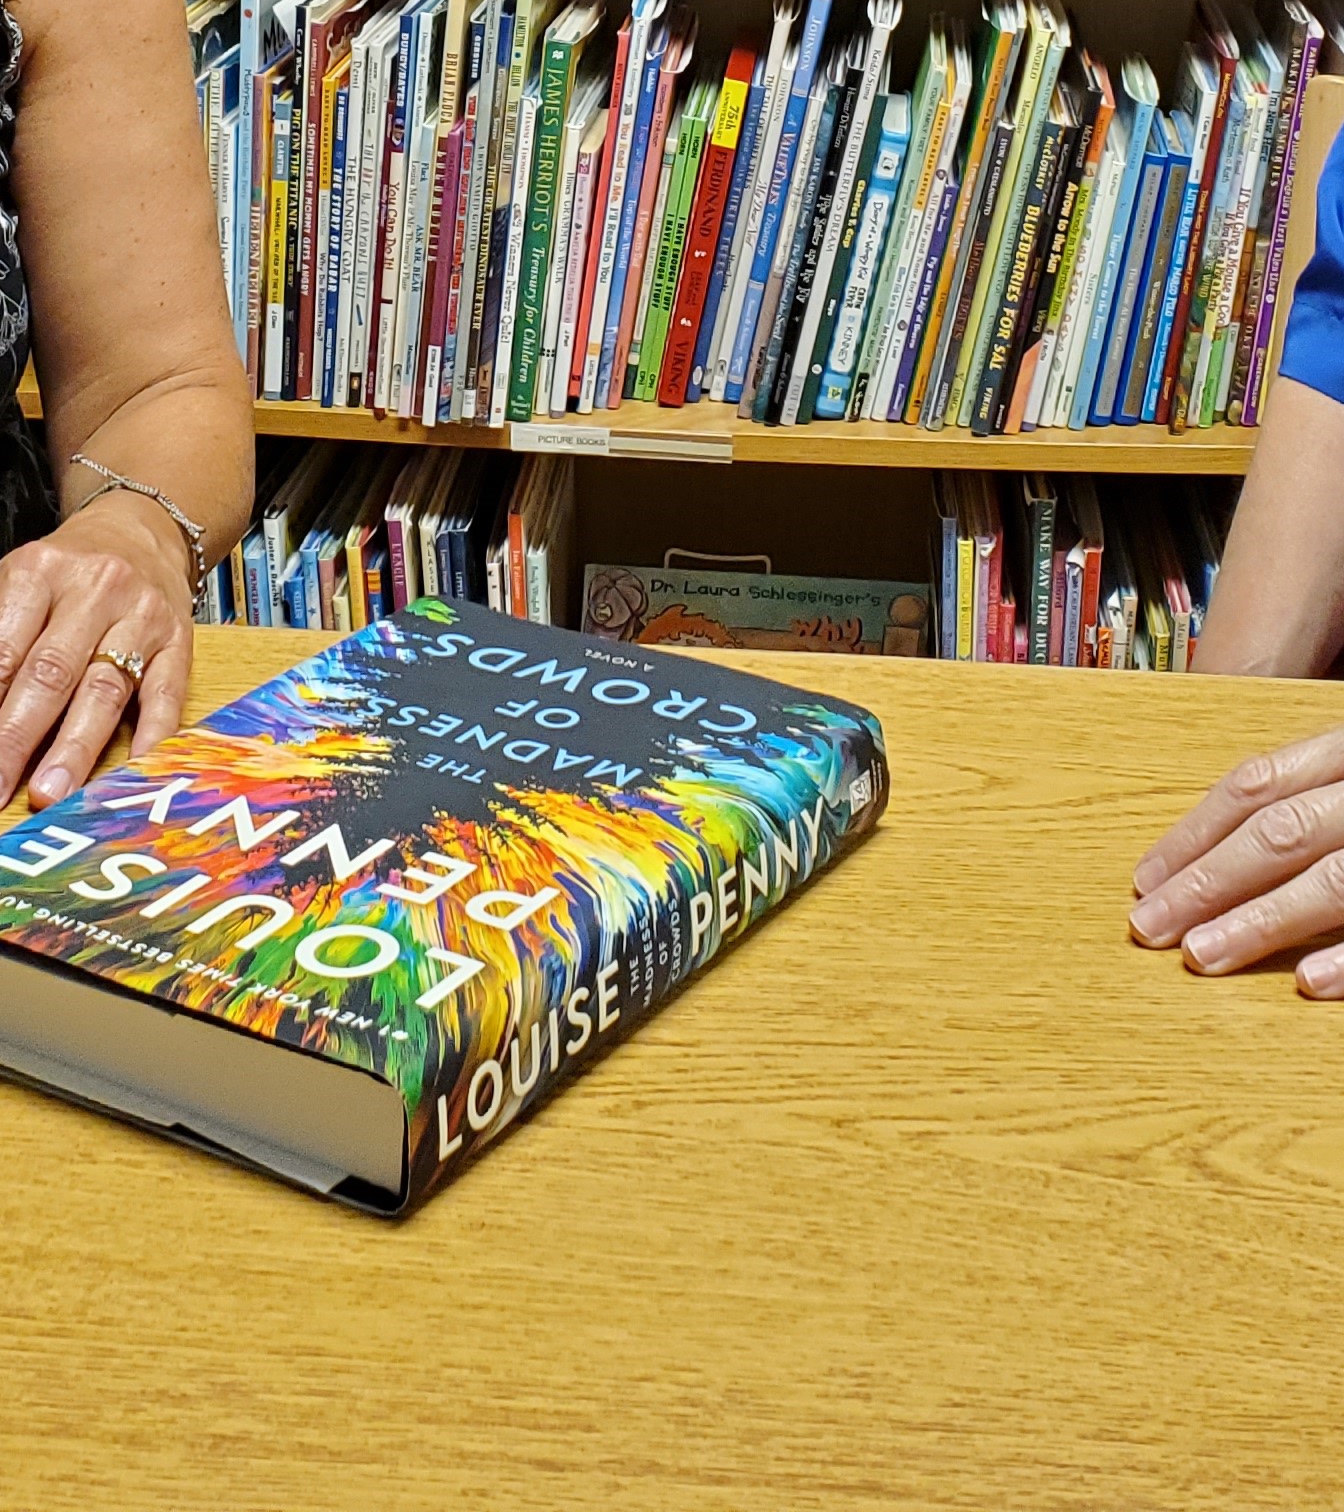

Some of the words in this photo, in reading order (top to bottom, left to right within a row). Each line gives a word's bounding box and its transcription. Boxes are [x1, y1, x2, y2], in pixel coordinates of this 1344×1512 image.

[542, 67, 565, 126] JAMES
[531, 135, 558, 232] HERRIOT'S
[698, 151, 729, 237] FERDINAND
[523, 246, 546, 303] Treasury
[1006, 205, 1041, 302] BLUEBERRIES
[522, 305, 540, 326] for
[997, 307, 1019, 338] FOR
[518, 329, 537, 384] Children
[989, 344, 1011, 371] SAL
[537, 436, 573, 444] PICTURE
[576, 437, 606, 446] BOOKS
[1039, 506, 1053, 552] MAKE
[651, 579, 676, 594] Dr.
[684, 580, 740, 598] Laura
[749, 587, 882, 607] Schlessinger's
[1038, 558, 1050, 590] WAY
[1036, 595, 1049, 625] FOR
[424, 630, 757, 734] CROWDS
[494, 699, 581, 730] OF
[361, 695, 644, 787] MADNESS
[415, 752, 486, 784] THE
[103, 777, 562, 932] PENNY
[437, 959, 621, 1161] LOUISE
[689, 802, 826, 959] PENNY
